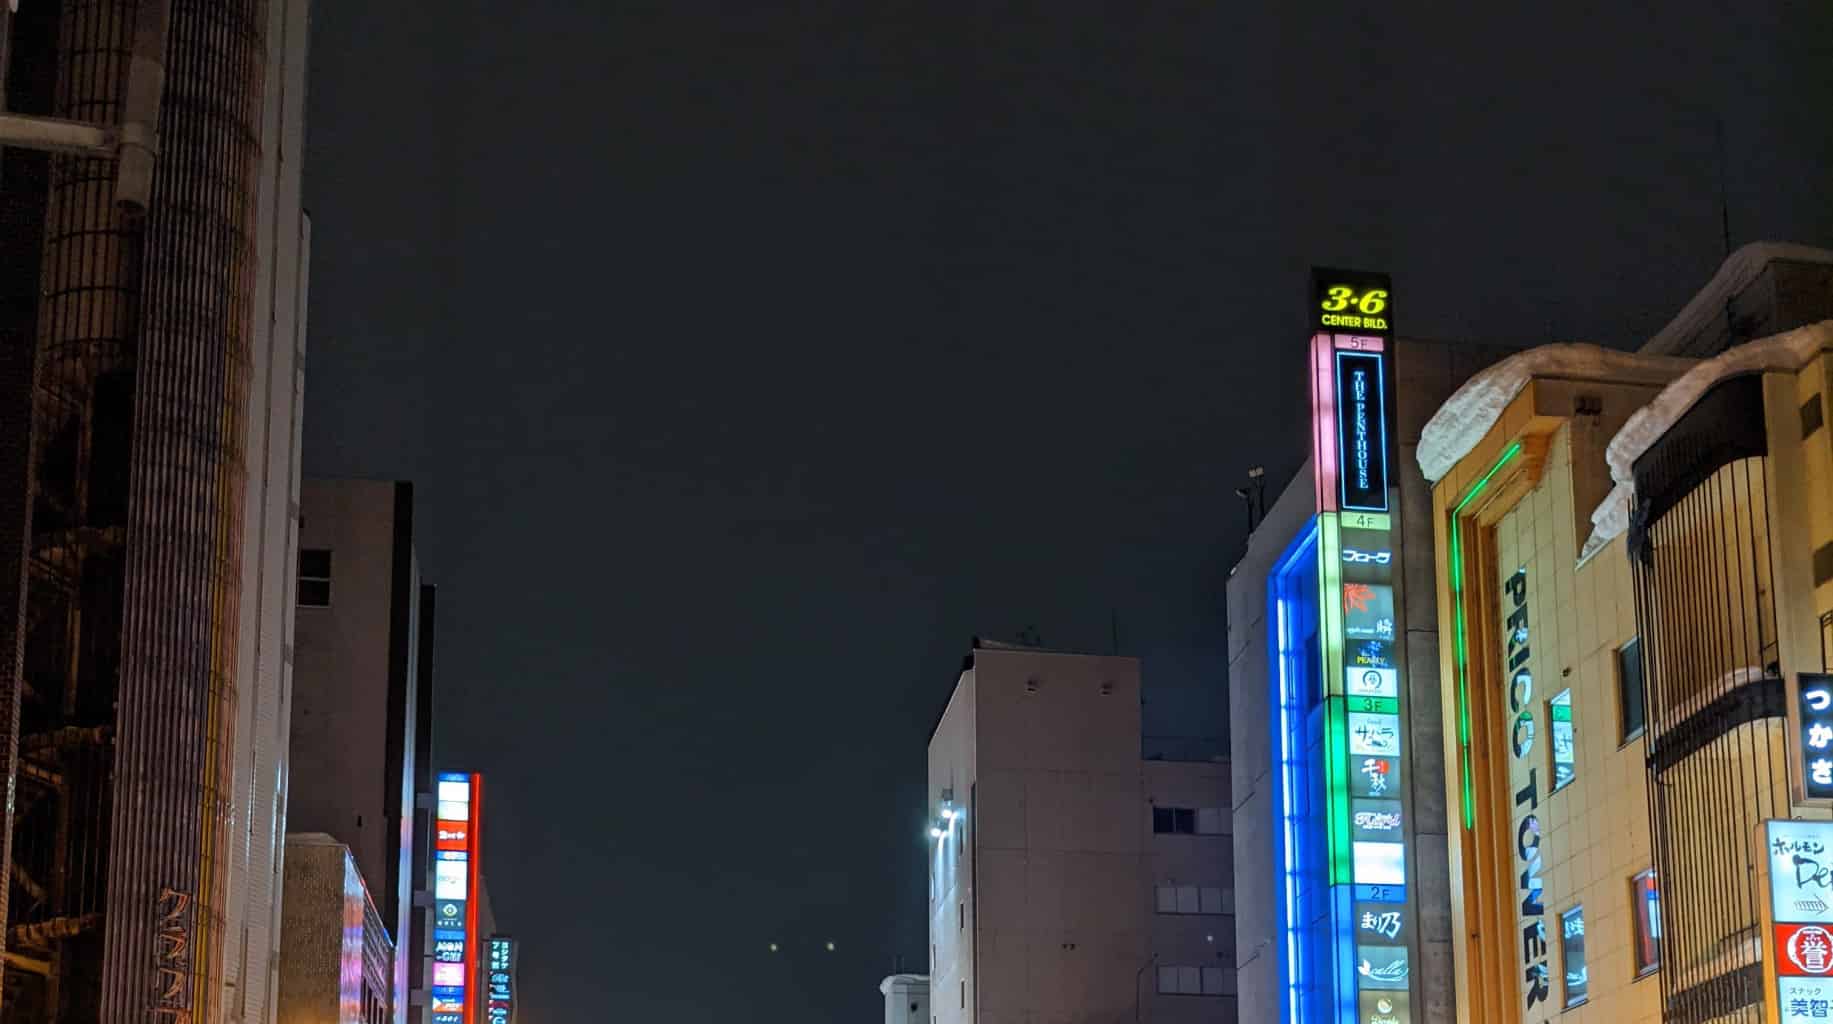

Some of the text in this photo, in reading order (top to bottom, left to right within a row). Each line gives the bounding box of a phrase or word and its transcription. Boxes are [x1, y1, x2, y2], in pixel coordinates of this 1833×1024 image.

[1321, 314, 1361, 329] CENTER
[1350, 336, 1369, 349] 5F
[1353, 370, 1370, 489] THE PENTHOUSE
[1356, 515, 1375, 529] 4F
[1504, 567, 1536, 760] PRICO
[1363, 698, 1383, 712] 3F
[1805, 689, 1833, 785] つかさ
[1772, 837, 1825, 856] ホルモン
[1370, 886, 1392, 900] 2F
[1515, 767, 1551, 1012] TOWER
[1360, 911, 1402, 940] まり乃
[1788, 986, 1823, 997] スナック
[1790, 998, 1833, 1018] 美智
